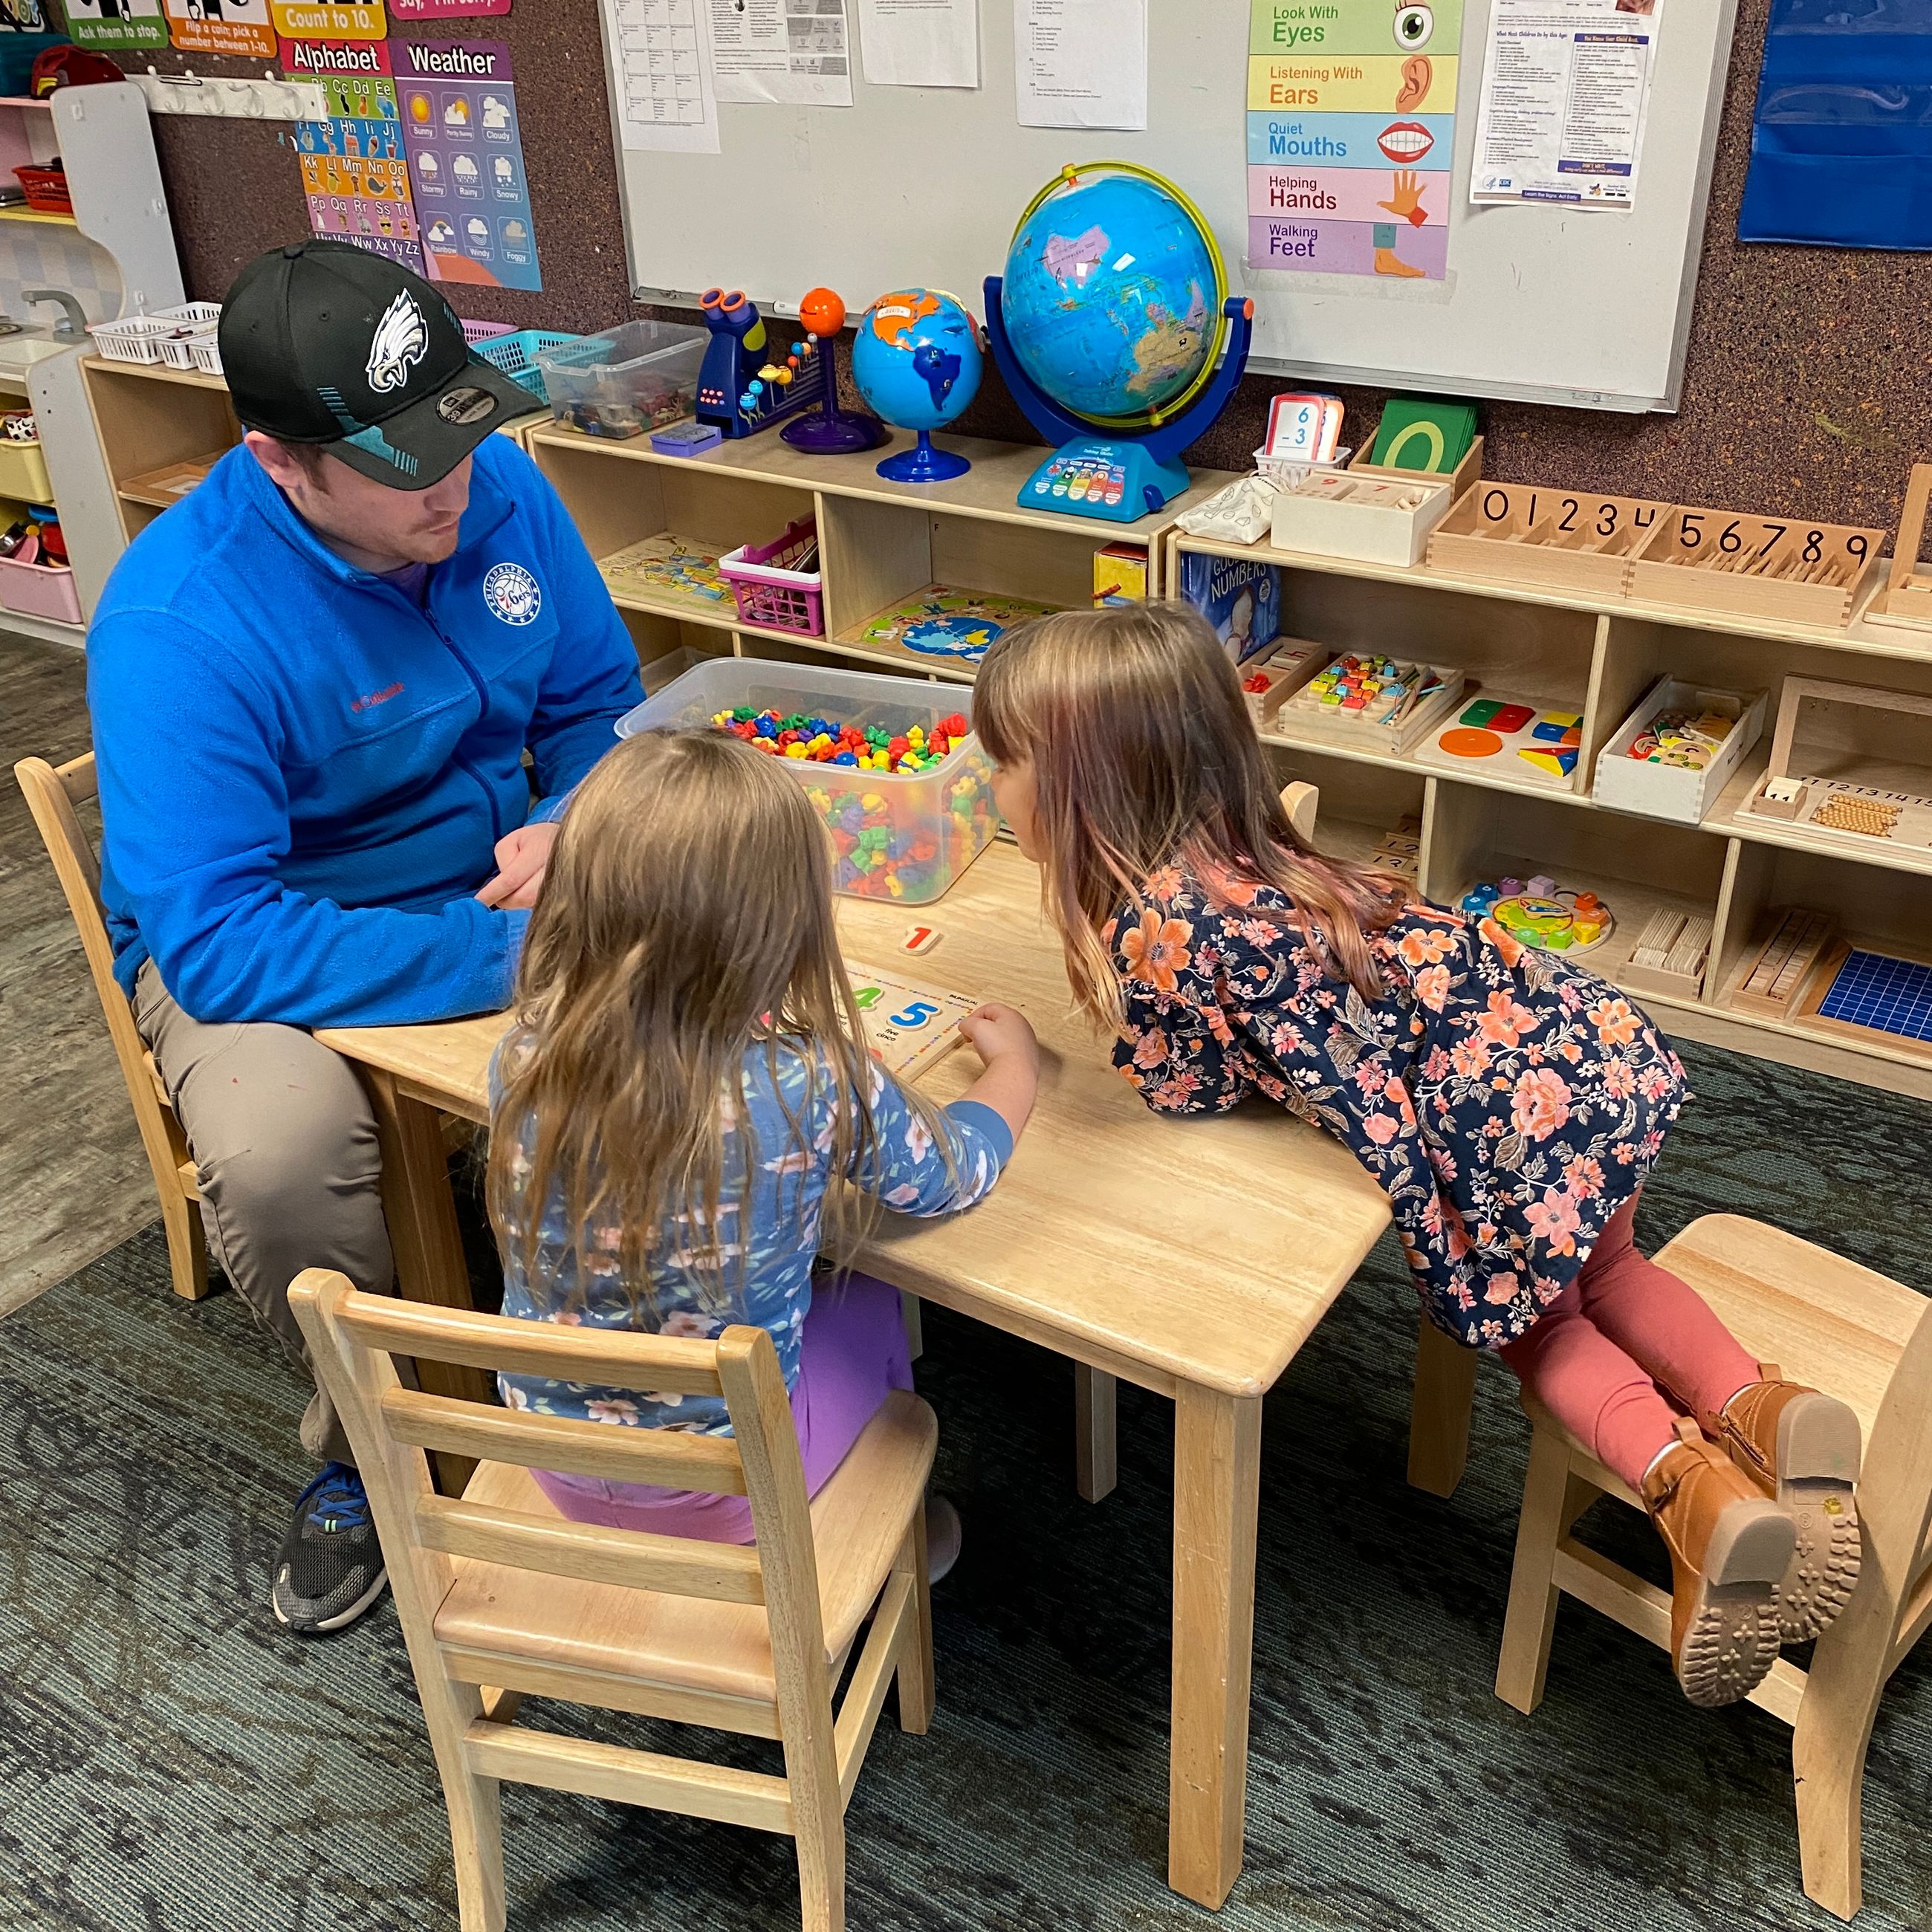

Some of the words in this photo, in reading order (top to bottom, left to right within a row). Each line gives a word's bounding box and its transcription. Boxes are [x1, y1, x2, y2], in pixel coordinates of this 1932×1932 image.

[286, 10, 328, 28] Count
[334, 11, 349, 29] to
[351, 11, 375, 29] 10.
[1273, 6, 1305, 19] Look
[1309, 7, 1338, 19] With
[79, 26, 94, 39] Ask
[97, 25, 122, 39] them
[124, 25, 134, 38] to
[137, 26, 161, 40] stop.
[186, 21, 201, 33] Flip
[203, 25, 209, 33] a
[233, 25, 250, 39] pick
[253, 30, 259, 38] a
[1273, 21, 1325, 47] Eyes
[179, 33, 211, 46] number
[213, 37, 248, 51] between
[250, 39, 270, 53] 1-10.
[294, 42, 380, 73] Alphabet
[409, 45, 496, 75] Weather
[1270, 66, 1329, 82] Listening
[1333, 66, 1363, 80] With
[332, 80, 349, 94] Cc
[353, 80, 369, 94] Dd
[375, 81, 392, 95] Ee
[1270, 84, 1318, 104] Ears
[318, 120, 334, 135] Gg
[340, 120, 357, 134] Hh
[365, 121, 374, 134] Ii
[383, 123, 395, 139] Jj
[413, 127, 432, 137] Sunny
[486, 131, 510, 142] Cloudy
[1268, 122, 1303, 135] Quiet
[1269, 135, 1347, 157] Mouths
[304, 156, 318, 169] Kk
[326, 158, 337, 170] Ll
[343, 159, 362, 172] Mm
[368, 160, 383, 174] Nn
[388, 162, 405, 175] Oo
[421, 184, 444, 195] Stormy
[459, 187, 478, 197] Rainy
[1269, 175, 1317, 191] Helping
[496, 190, 519, 200] Snowy
[1270, 188, 1337, 210] Hands
[311, 195, 325, 211] Pp
[331, 198, 347, 214] Qq
[354, 199, 368, 213] Rr
[375, 201, 391, 215] Ss
[395, 203, 409, 216] Tt
[1269, 224, 1318, 240] Walking
[351, 236, 372, 250] Ww
[374, 238, 389, 251] Xx
[389, 239, 403, 256] Yy
[404, 242, 420, 256] Zz
[430, 244, 458, 254] Rainbow
[470, 248, 490, 259] Windy
[1270, 237, 1316, 257] Feet
[507, 252, 526, 262] Foggy
[1298, 407, 1309, 423] 6
[1295, 428, 1306, 444] 3
[1483, 489, 1510, 522] 0
[1528, 494, 1537, 526] 1
[1559, 499, 1580, 532] 2
[1597, 504, 1618, 537] 3
[1680, 514, 1705, 548] 5
[1719, 520, 1743, 553] 6
[1758, 524, 1786, 557] 7
[1801, 530, 1824, 564] 8
[1847, 534, 1869, 569] 9
[485, 565, 532, 607] PHILADELPHIA
[1211, 561, 1266, 603] NUMBERS
[497, 590, 531, 609] 76ers
[1827, 782, 1850, 791] 12
[1855, 787, 1878, 797] 13
[1884, 792, 1907, 802] 14
[906, 927, 932, 949] 1
[948, 993, 979, 1005] BILINGUAL
[889, 1002, 939, 1027] 5
[876, 1033, 896, 1042] cinco
[885, 1028, 899, 1037] five
